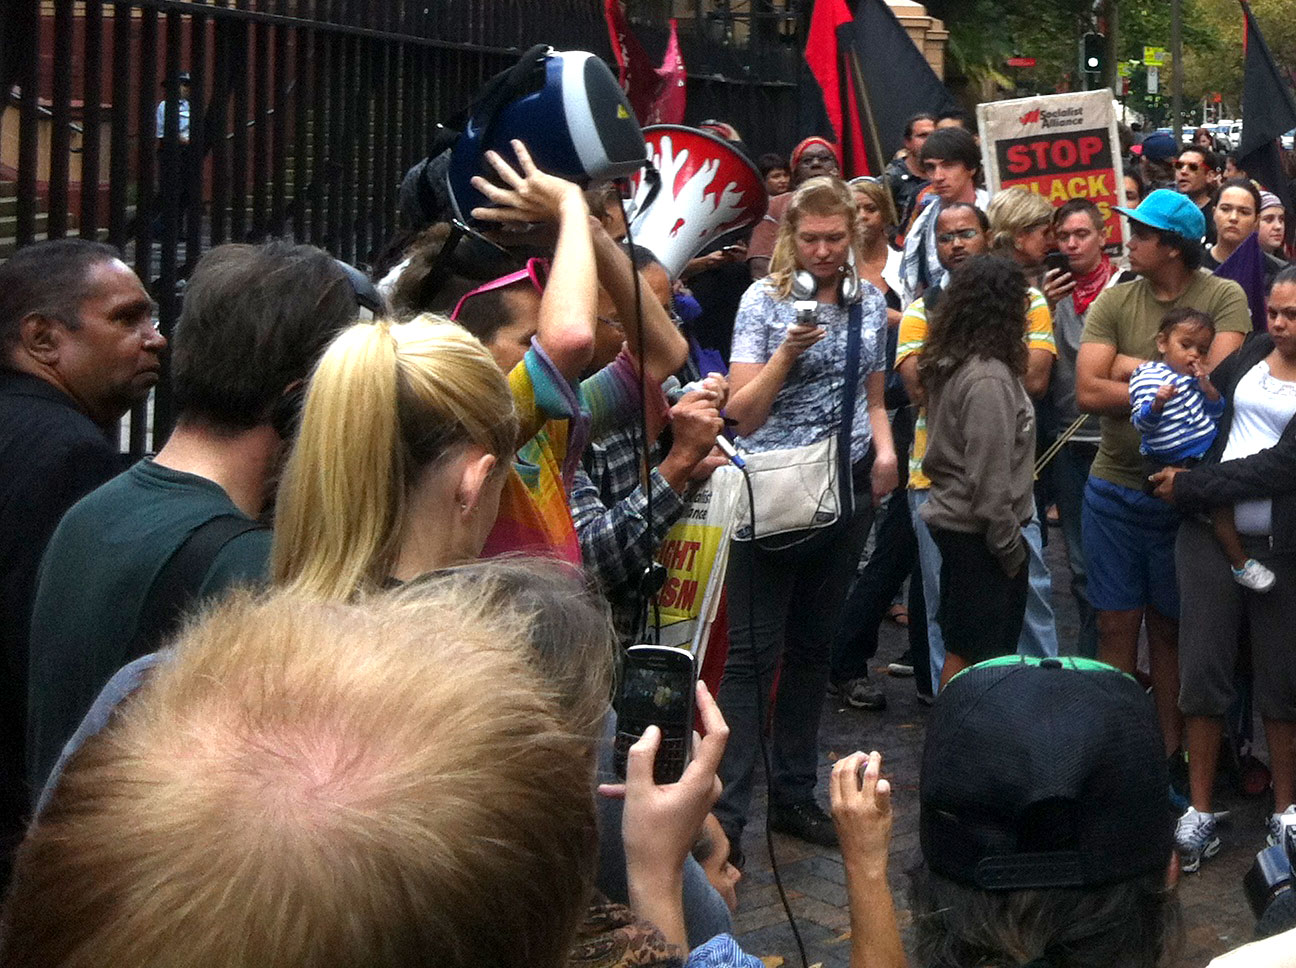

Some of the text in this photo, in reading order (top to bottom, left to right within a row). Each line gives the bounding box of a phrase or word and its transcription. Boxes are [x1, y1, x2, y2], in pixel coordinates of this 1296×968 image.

[1040, 105, 1083, 121] Socialist
[1041, 116, 1083, 129] Alliance
[1006, 135, 1104, 174] STOP
[1010, 174, 1110, 202] LACK
